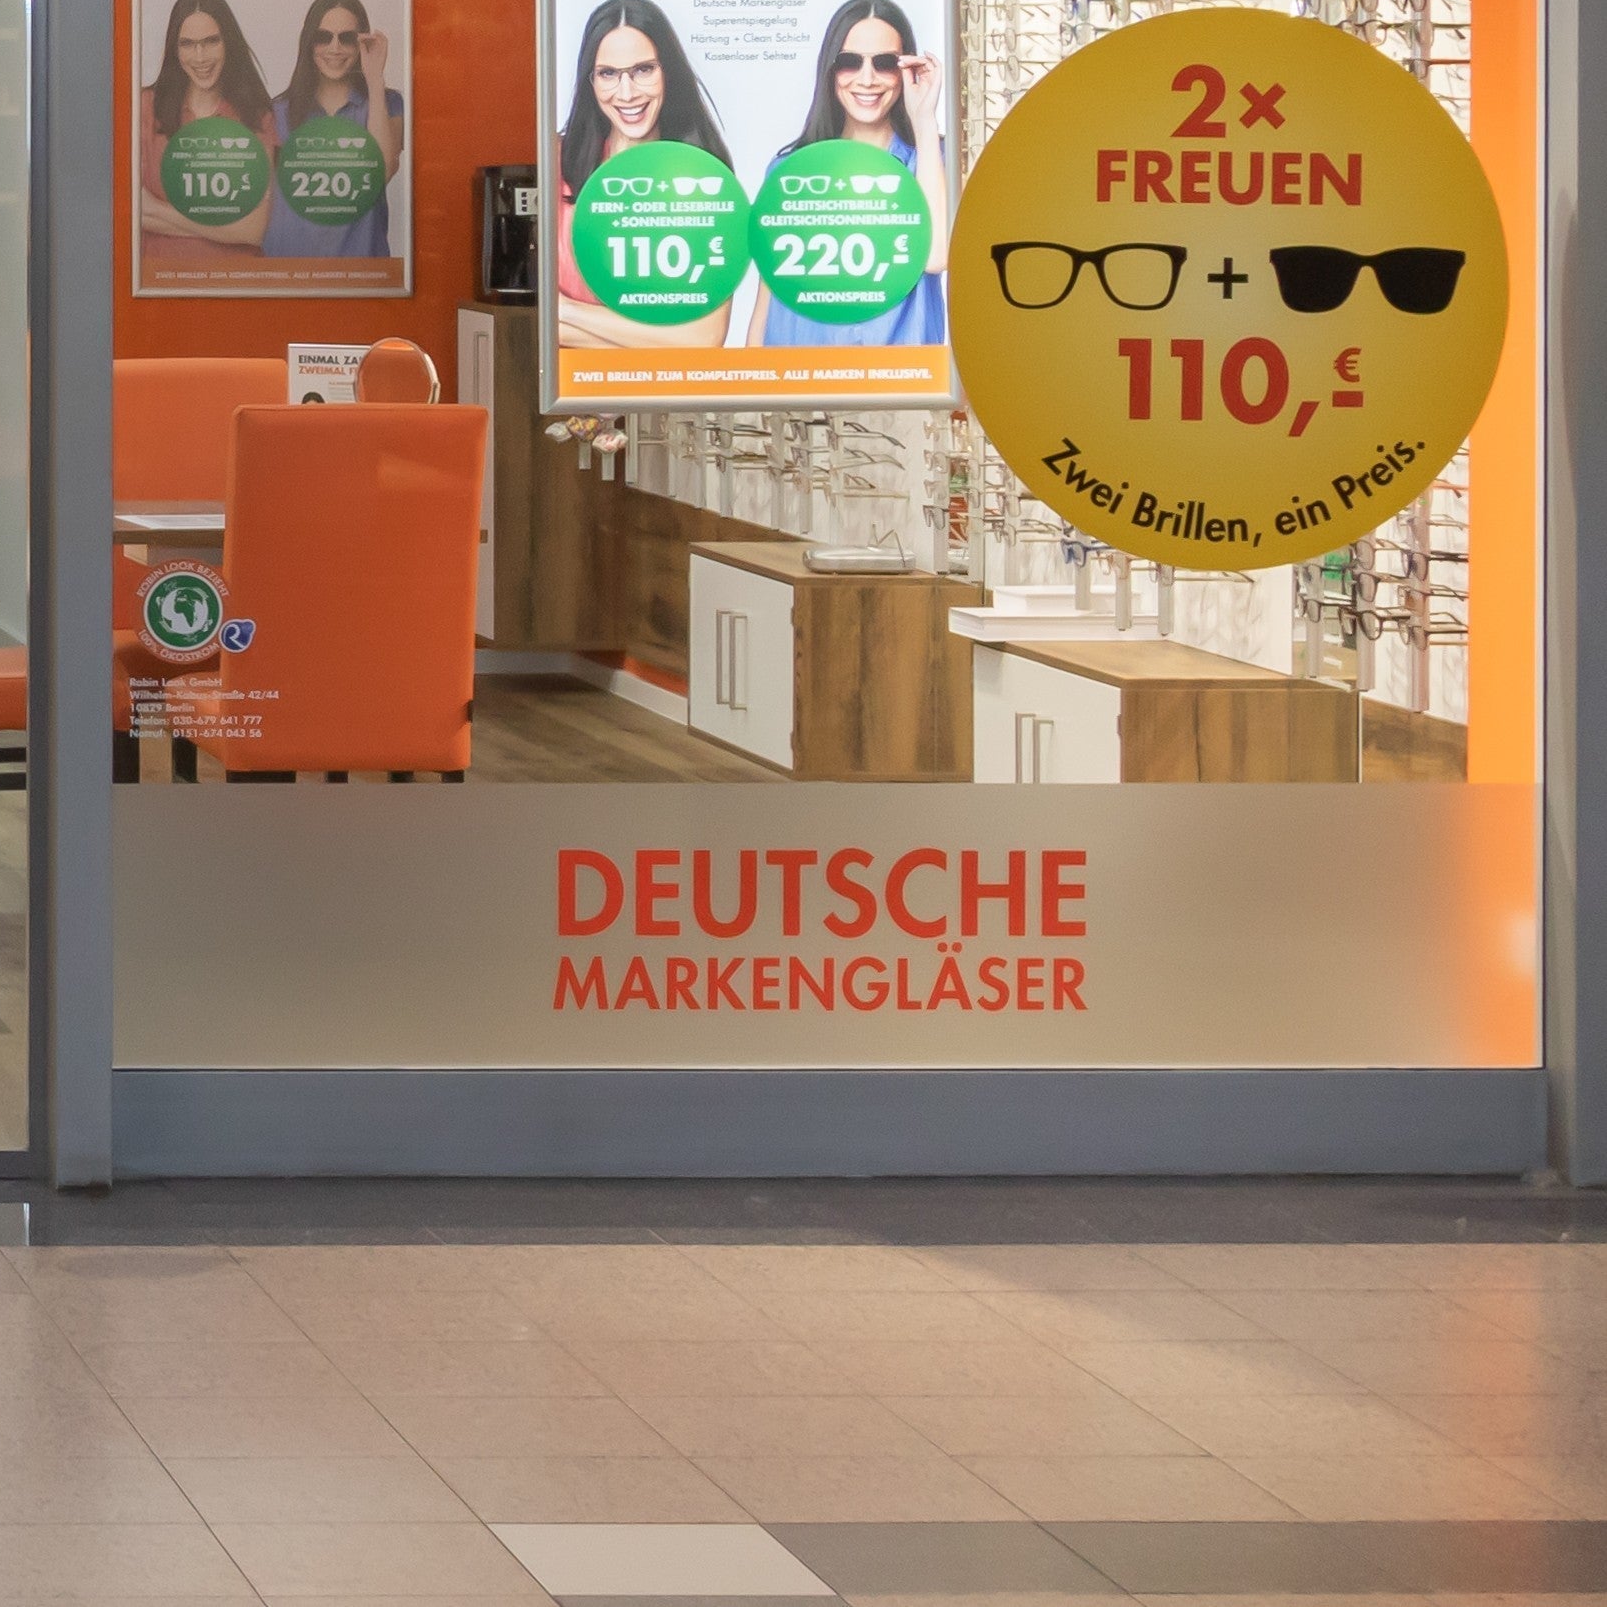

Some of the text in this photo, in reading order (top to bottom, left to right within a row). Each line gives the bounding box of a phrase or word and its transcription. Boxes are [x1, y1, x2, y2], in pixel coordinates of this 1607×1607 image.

[703, 15, 797, 27] Superentspiegelung
[690, 33, 810, 45] Härtung Clean Schicht
[705, 51, 796, 60] Kostenloser Sehtest
[1096, 149, 1362, 205] FREUEN
[591, 201, 734, 213] FERN- ODER LESEBRILLE
[781, 200, 887, 211] GLEITSICHTBRILLE
[760, 214, 921, 226] GLEITSICHTSONNENBRILLE
[619, 293, 708, 304] AKTIONSPREIS
[797, 291, 885, 303] AKTIONSPREIS
[298, 355, 339, 364] EINMAL
[299, 366, 346, 375] ZWEIMAL
[573, 368, 932, 382] ZWEI BRILLEN ZUM KOMPLETTPREIS. ALLE MARKEN INKLUSIVE.
[1042, 437, 1426, 547] Zwei Brillen, ein Preis.
[136, 561, 230, 598] ROBIN LOOK BEZIEHT
[129, 678, 222, 686] Robin Look GmbH
[248, 691, 279, 700] 42/44
[220, 716, 262, 724] 641 777
[249, 729, 262, 737] 56
[557, 848, 1087, 938] DEUTSCHE
[552, 942, 1088, 1011] MARKENGLÄSER
